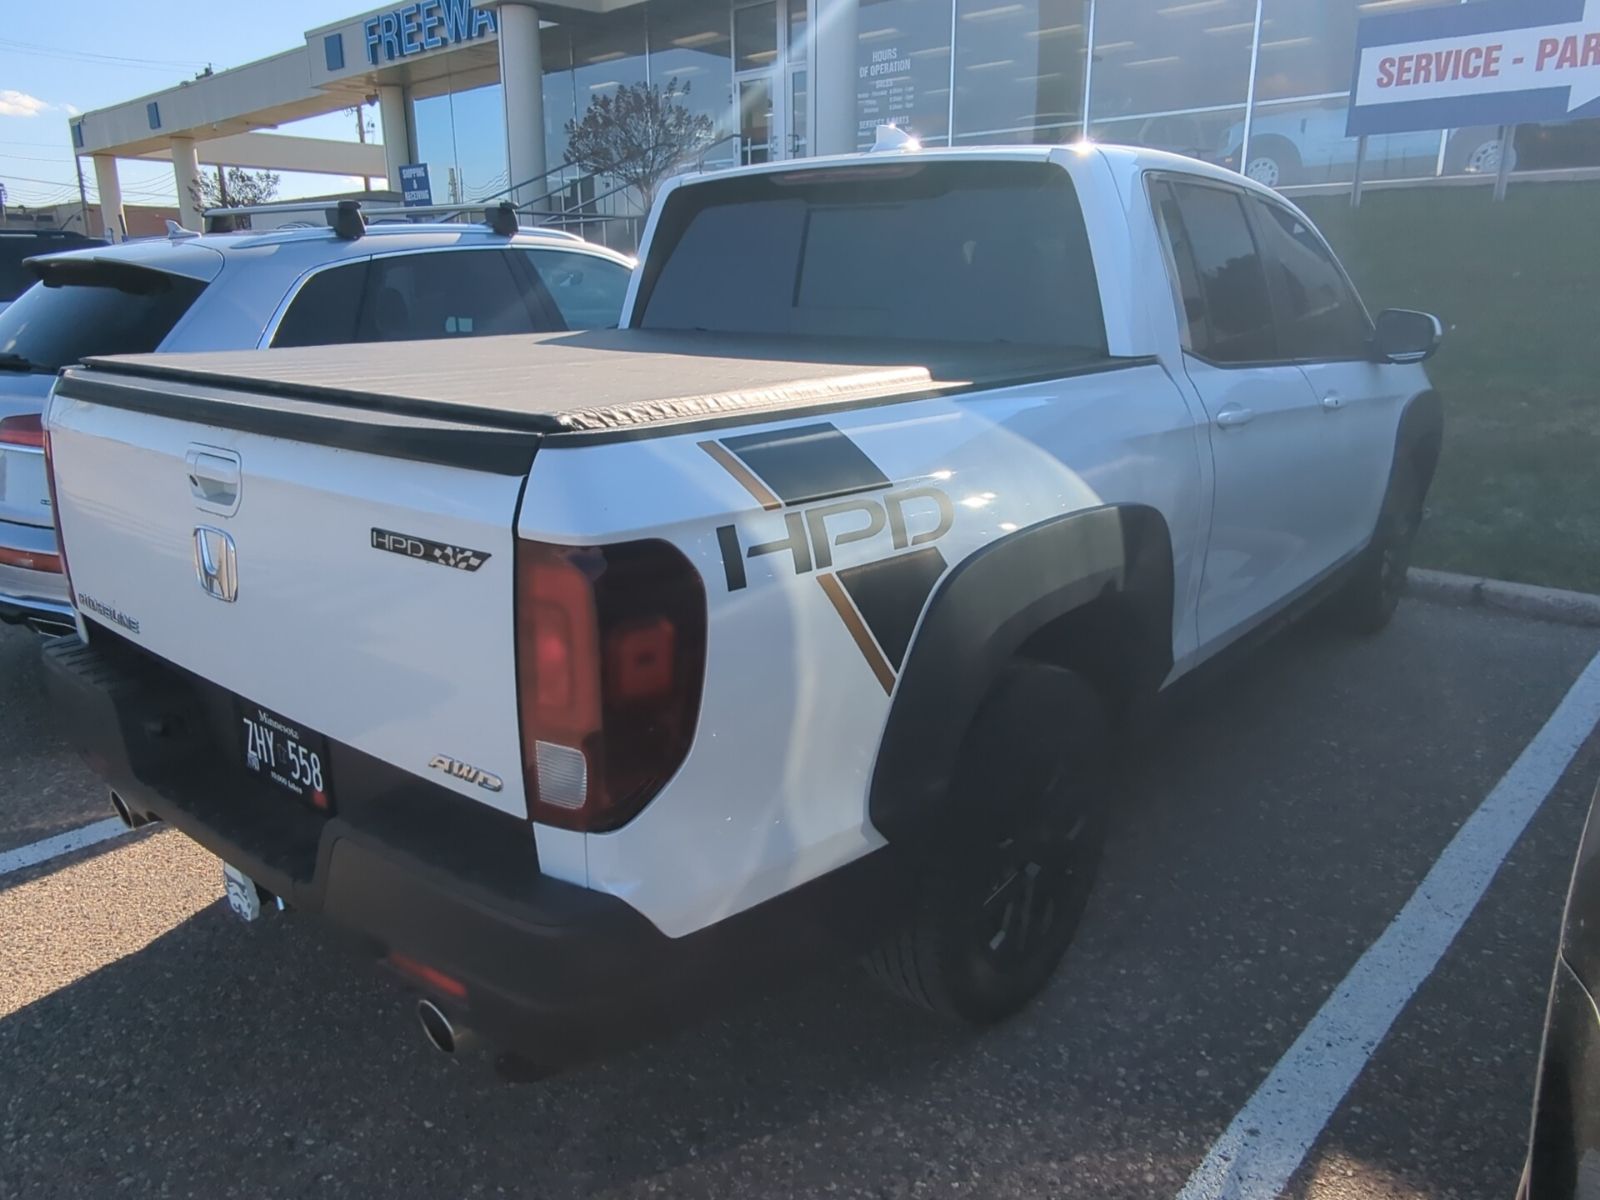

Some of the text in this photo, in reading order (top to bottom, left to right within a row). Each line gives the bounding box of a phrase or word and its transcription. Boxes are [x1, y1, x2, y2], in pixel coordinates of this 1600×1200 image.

[859, 58, 911, 78] OF OPERATION
[872, 47, 897, 63] HOURS
[1376, 45, 1503, 88] SERVICE
[1535, 32, 1600, 72] PAR
[372, 531, 425, 557] HPD
[715, 486, 954, 592] HPD
[258, 709, 299, 739] Minnesota
[243, 717, 323, 792] ZHY 558
[428, 754, 503, 792] AWD
